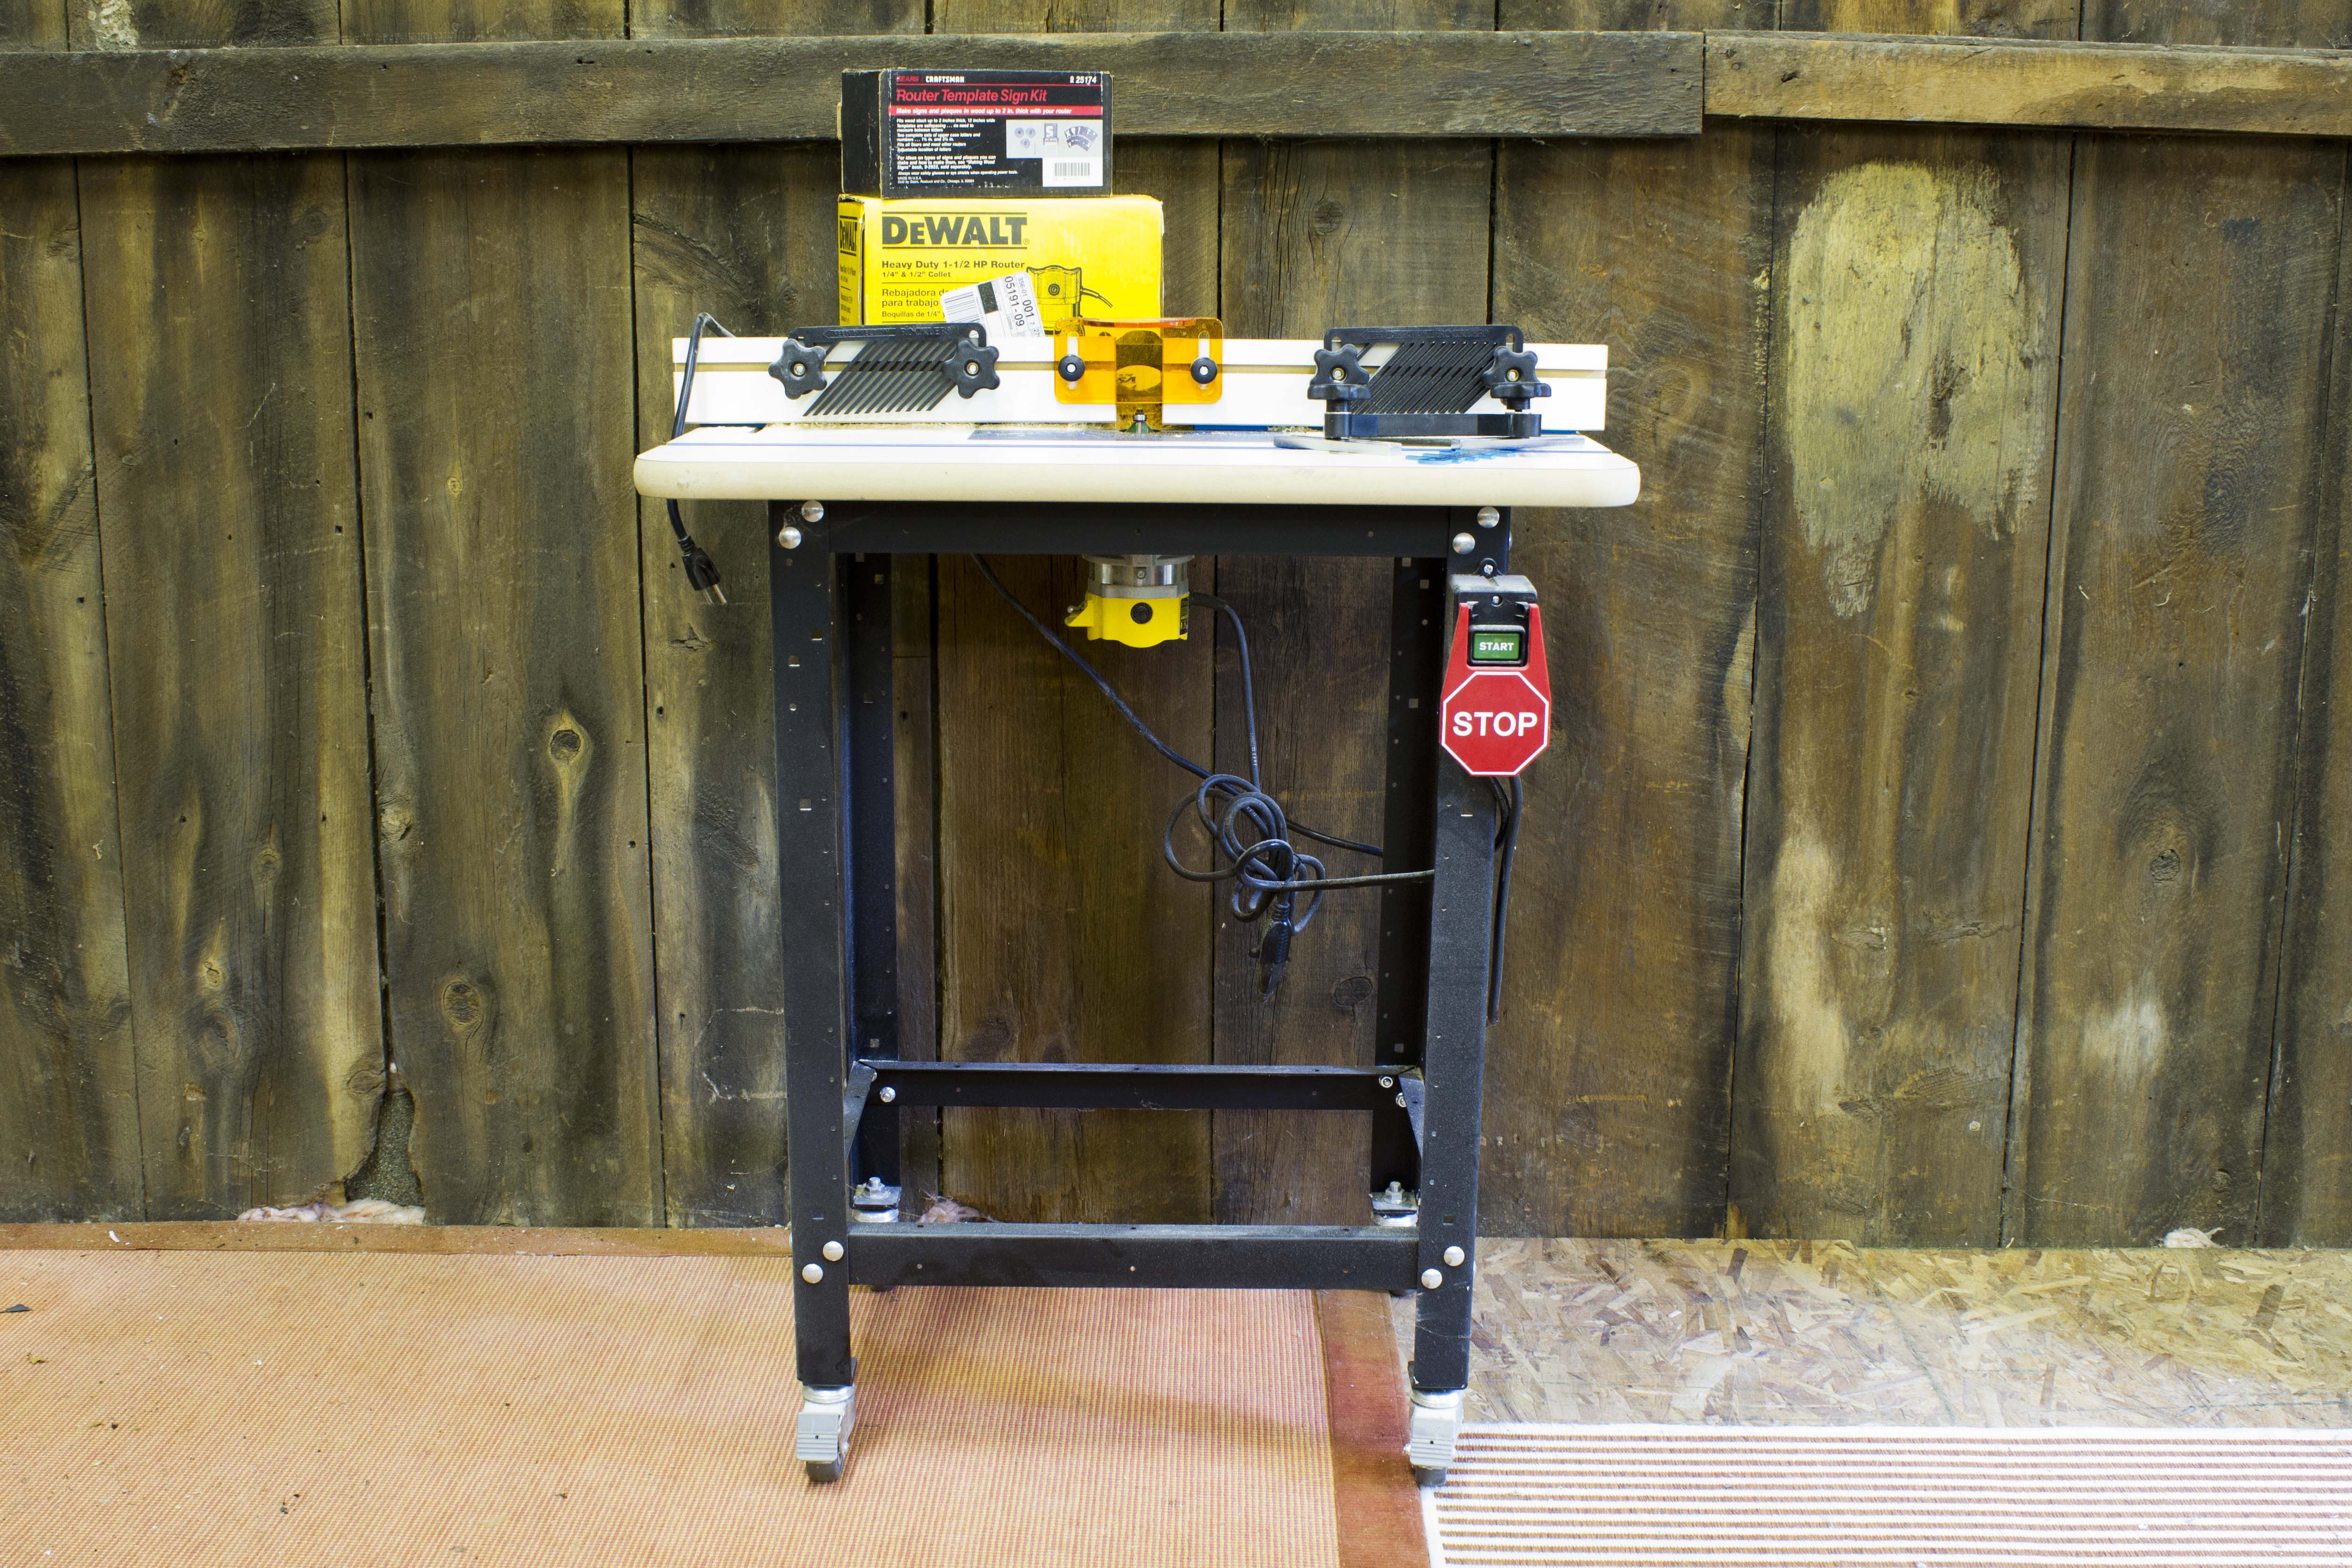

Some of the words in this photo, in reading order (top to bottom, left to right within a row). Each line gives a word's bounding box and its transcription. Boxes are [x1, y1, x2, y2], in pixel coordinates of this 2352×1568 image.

[896, 88, 940, 101] Router
[941, 88, 998, 104] Template
[1001, 89, 1028, 104] Sign
[1030, 89, 1047, 101] Kit
[882, 216, 1027, 245] DEWALT
[882, 261, 912, 269] Heavy
[916, 261, 939, 269] Duty
[882, 289, 935, 297] Rebajadora
[1005, 276, 1025, 326] 05191-09
[906, 299, 939, 308] trabajo
[1023, 299, 1035, 318] 001
[1479, 642, 1514, 651] START
[1453, 712, 1537, 737] STOP
